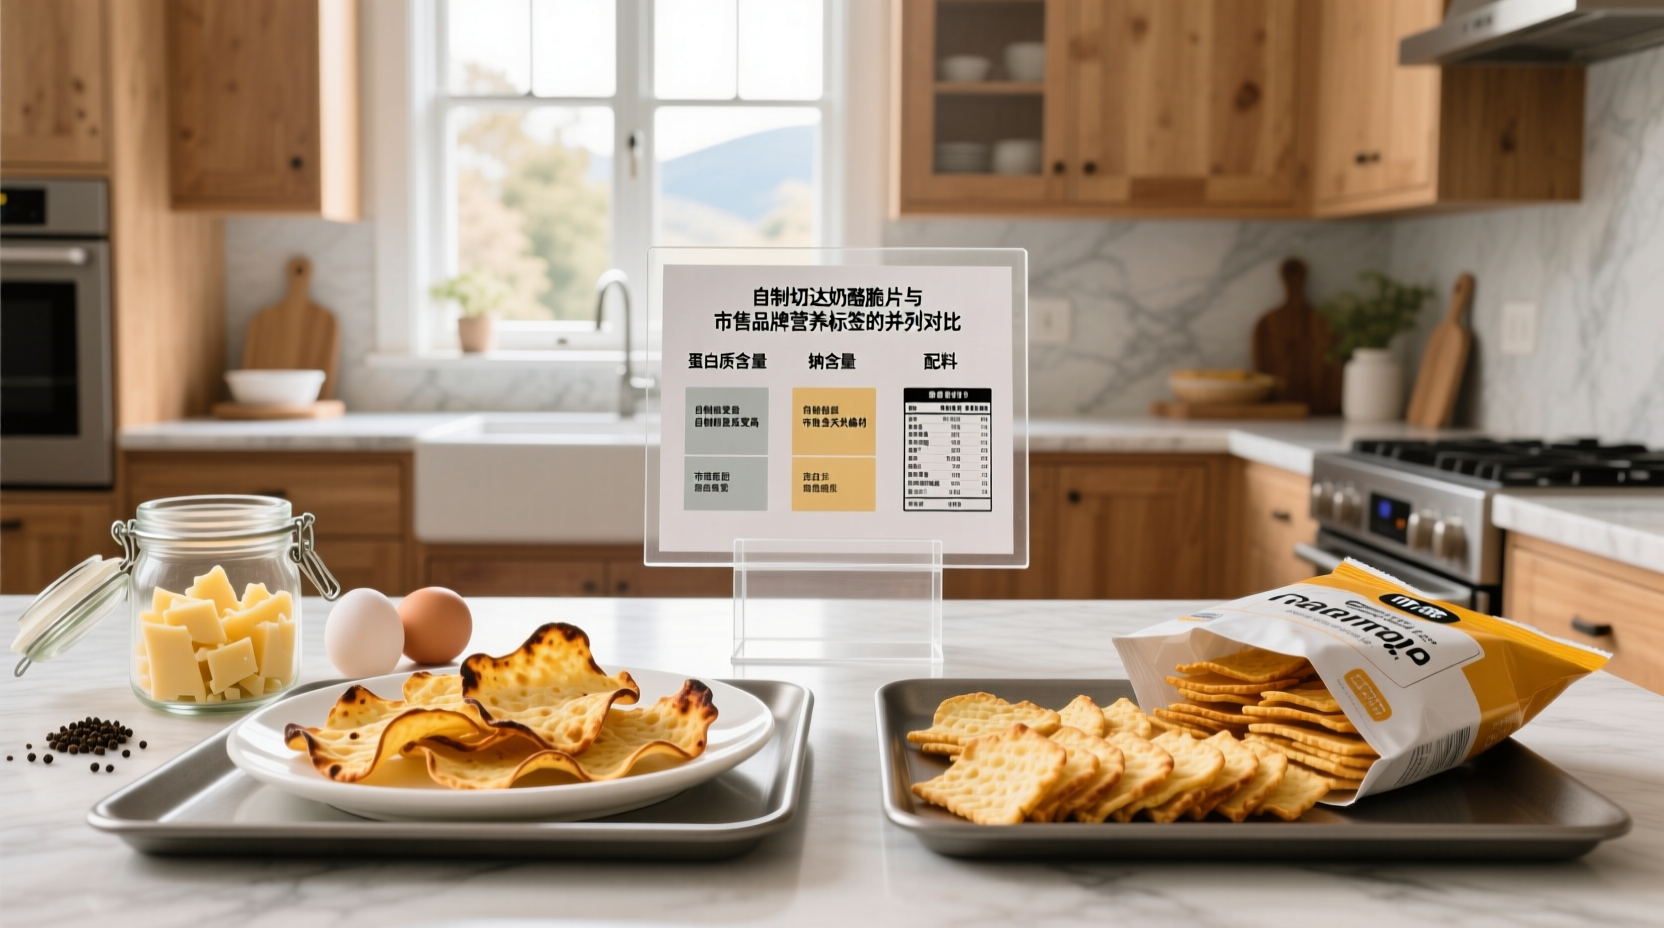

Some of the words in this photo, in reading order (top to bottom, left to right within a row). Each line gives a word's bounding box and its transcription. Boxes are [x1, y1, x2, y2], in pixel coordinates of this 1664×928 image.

[714, 310, 961, 332] 市售品牌营养标签的并列对比
[688, 352, 767, 370] 蛋白质含量
[923, 352, 958, 370] 配料
